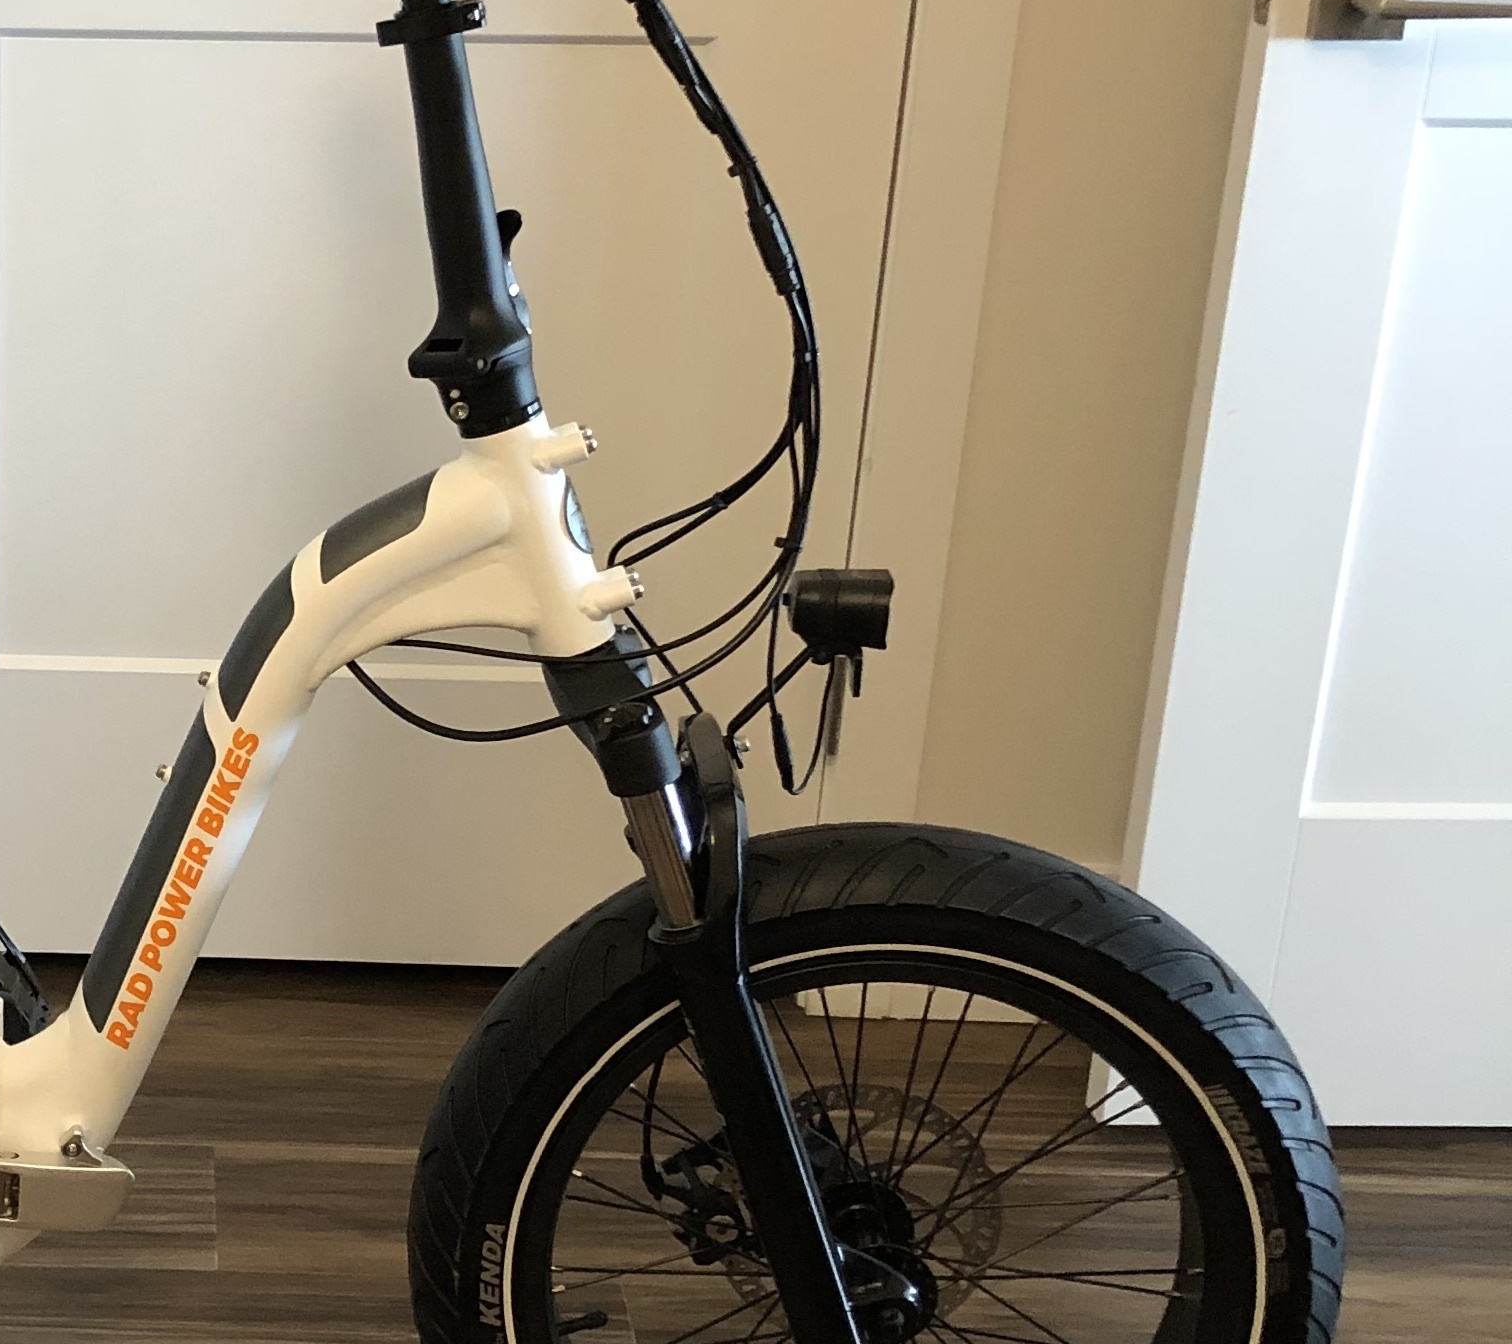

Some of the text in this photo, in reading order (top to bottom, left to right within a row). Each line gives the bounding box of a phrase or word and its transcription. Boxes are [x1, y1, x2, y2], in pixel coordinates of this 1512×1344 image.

[106, 726, 260, 1050] RAD POWER BIKES
[478, 1223, 506, 1327] KENDA
